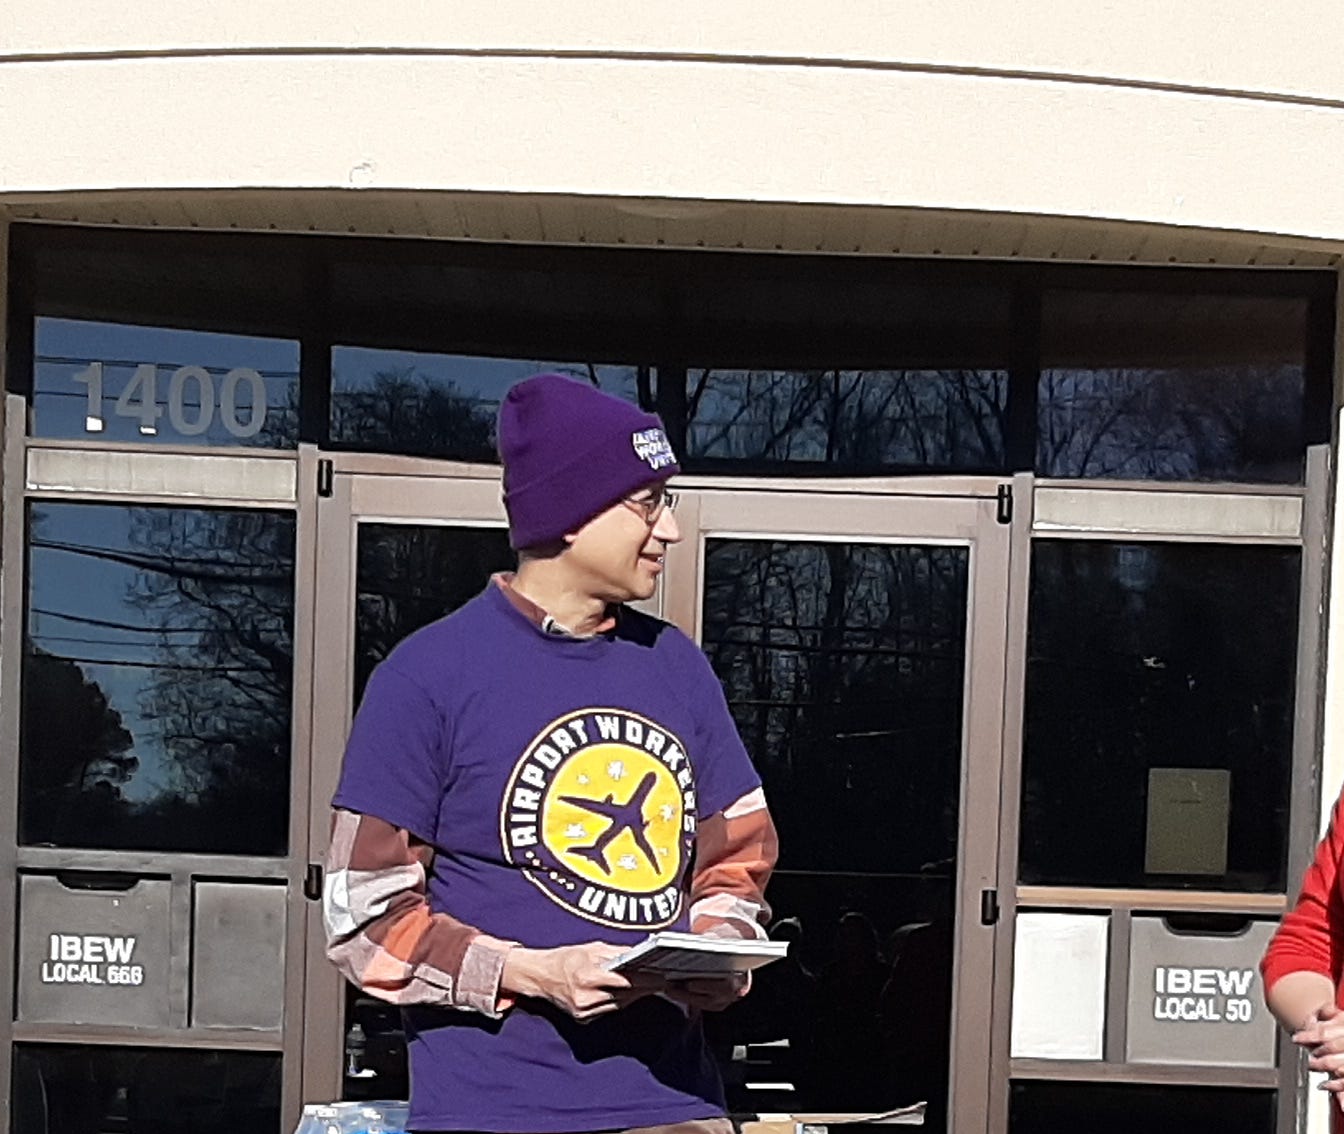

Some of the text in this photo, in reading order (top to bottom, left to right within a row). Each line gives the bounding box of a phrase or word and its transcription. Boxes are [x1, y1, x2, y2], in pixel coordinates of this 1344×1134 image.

[73, 361, 267, 438] 1400
[510, 714, 697, 847] AIRPORT WORKERS
[50, 934, 136, 964] IBEW
[42, 962, 103, 984] LOCAL
[1156, 967, 1253, 996] IBEW
[1155, 996, 1252, 1022] LOCAL 50
